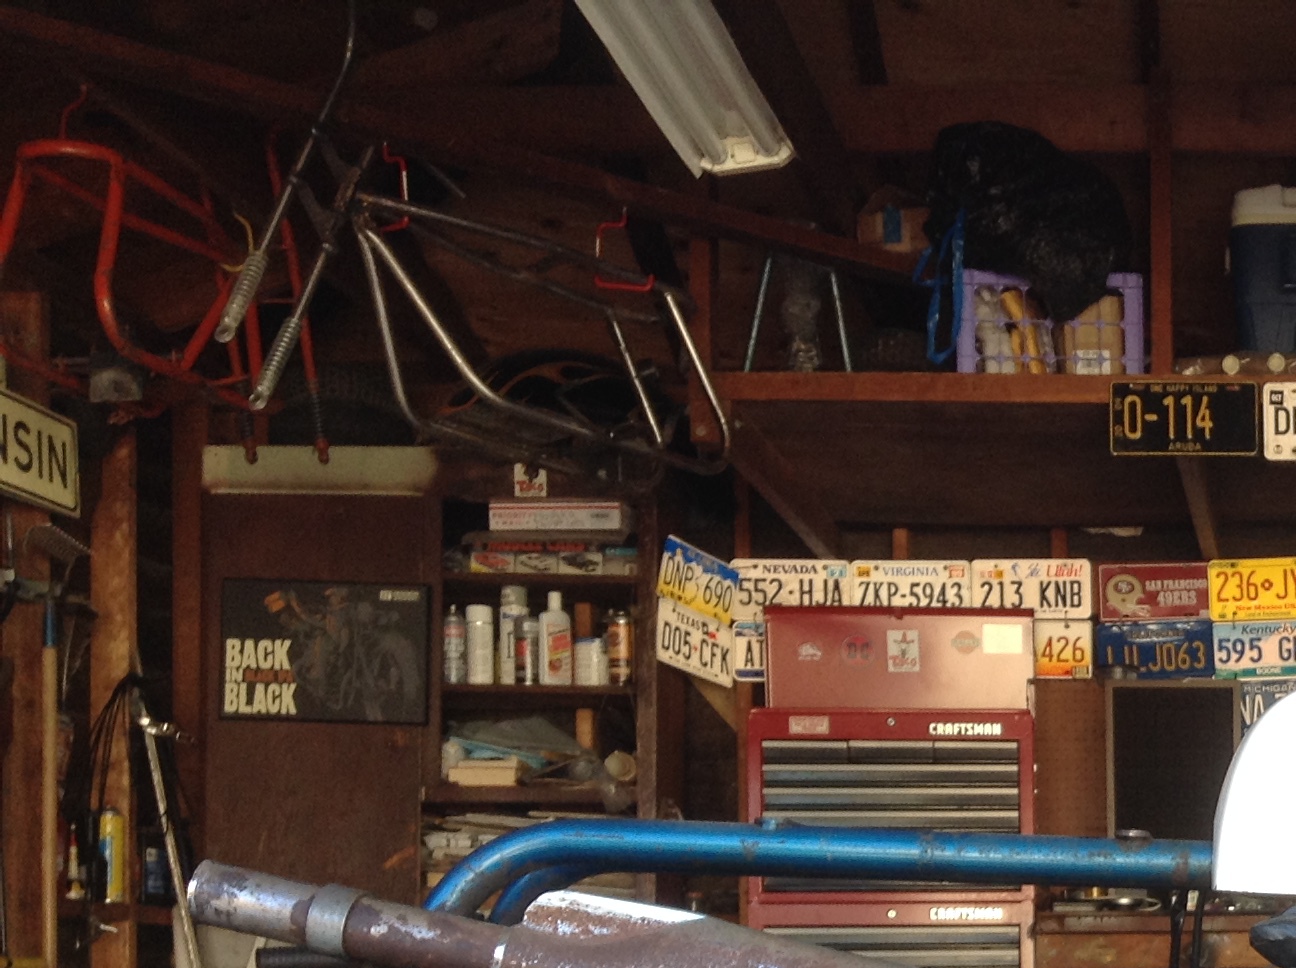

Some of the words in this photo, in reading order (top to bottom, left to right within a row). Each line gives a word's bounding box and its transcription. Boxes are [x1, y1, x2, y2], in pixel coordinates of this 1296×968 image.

[1168, 441, 1201, 451] ARUBA
[762, 564, 818, 574] NEVADA
[882, 566, 939, 577] VIRGINIA
[1145, 580, 1162, 591] SAN
[1215, 570, 1259, 603] 236
[980, 580, 1023, 608] 213
[1039, 580, 1082, 608] KNB
[1157, 590, 1197, 607] 49ERS
[676, 611, 700, 631] TEXAS
[1241, 622, 1296, 635] Kentucky
[225, 638, 292, 670] BACK
[699, 638, 730, 676] CFK
[1218, 637, 1262, 664] 595
[226, 668, 244, 683] IN
[223, 682, 297, 715] BLACK
[929, 722, 1002, 736] CRAFTSMAN
[929, 907, 1004, 920] CRAFTSMAN
